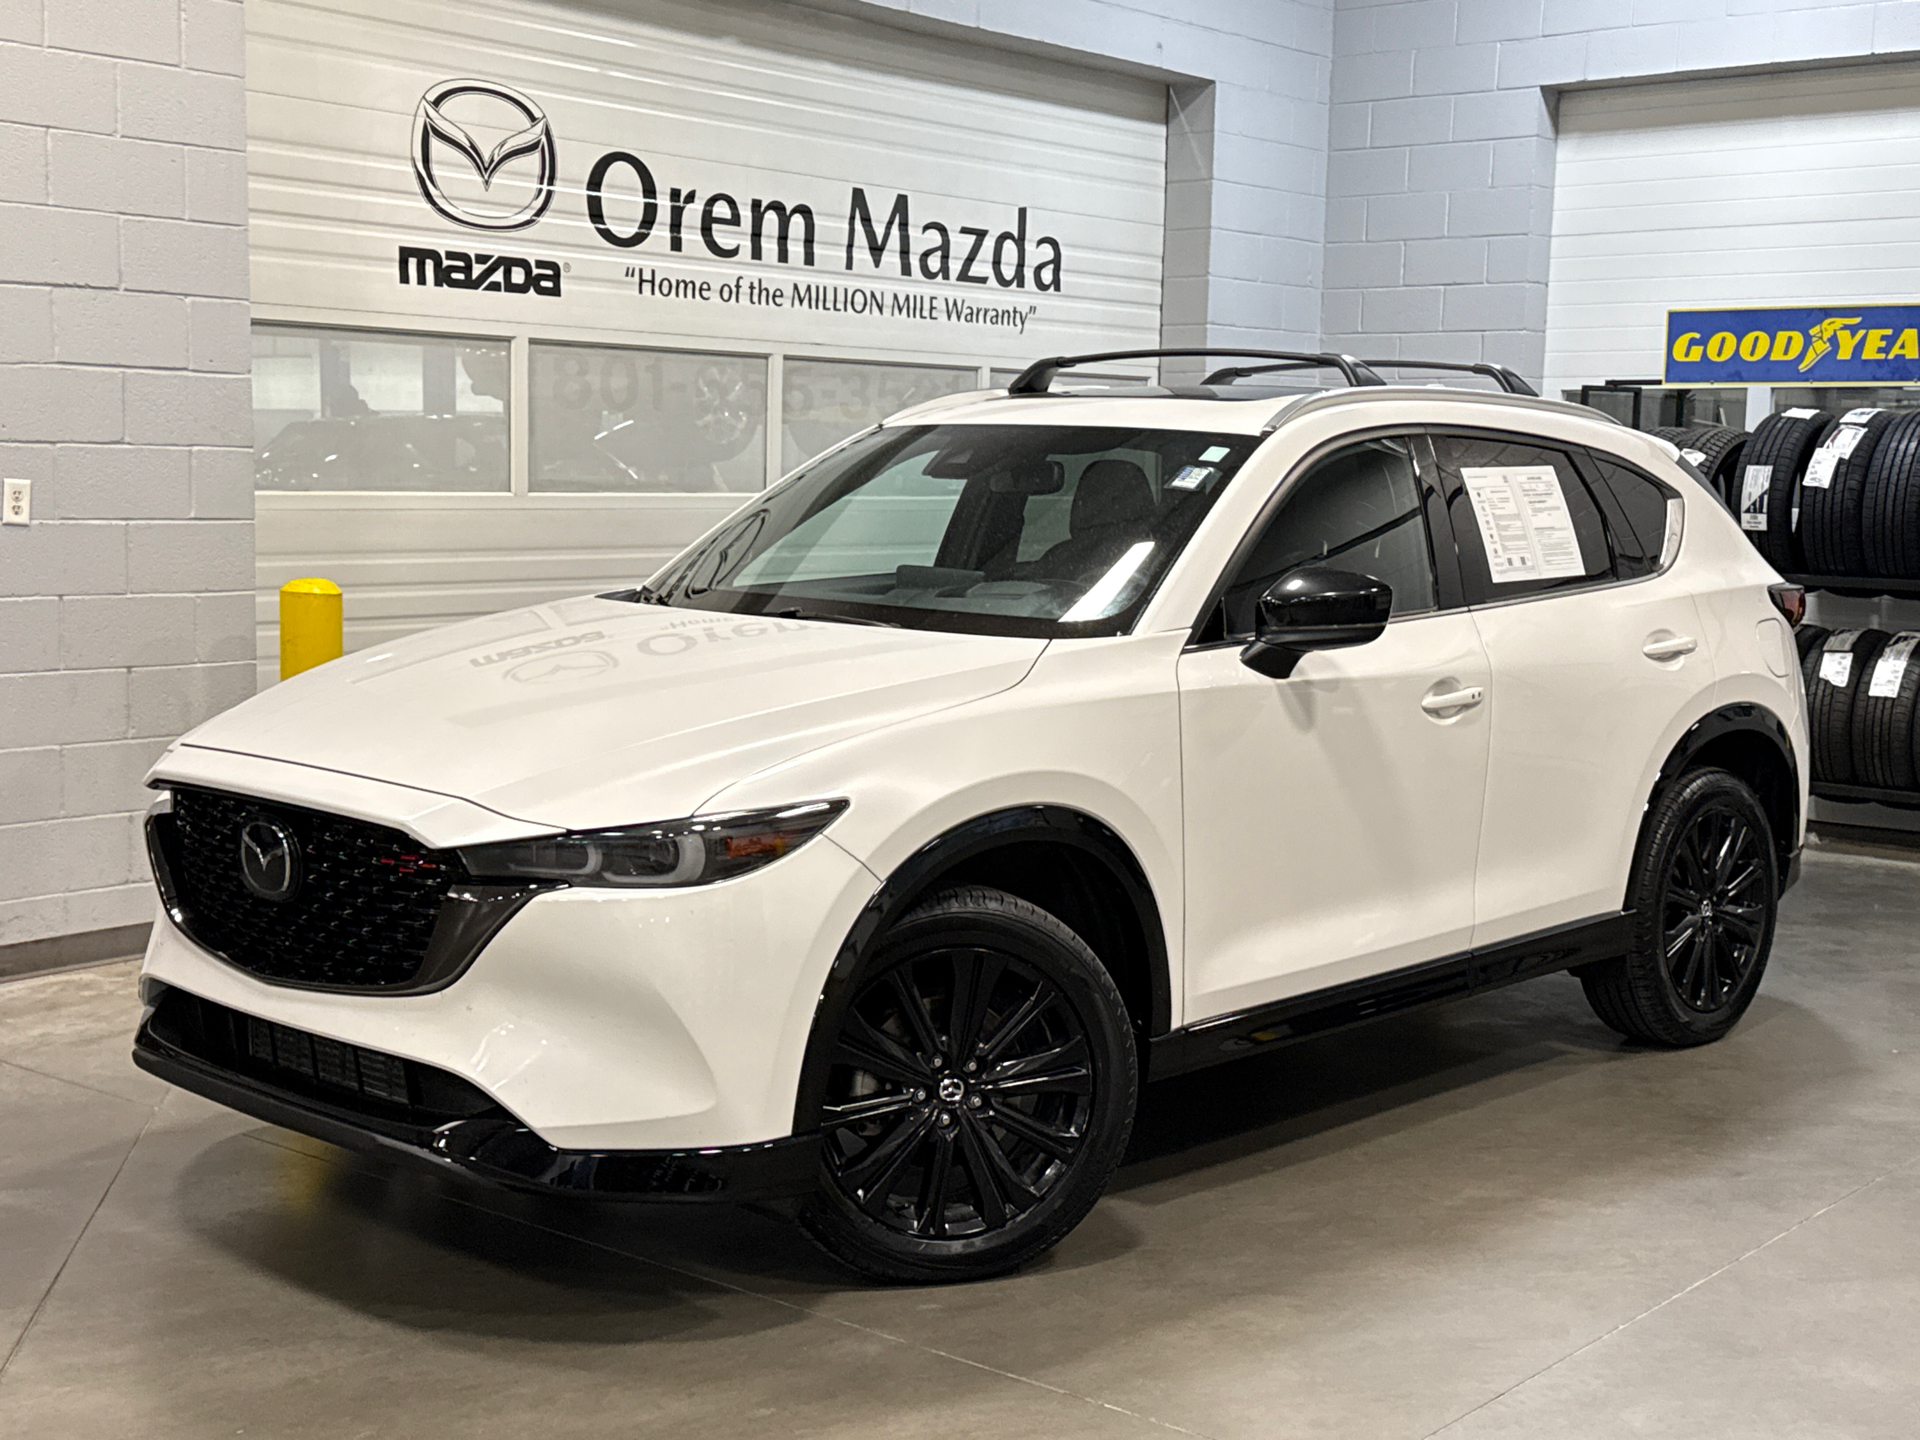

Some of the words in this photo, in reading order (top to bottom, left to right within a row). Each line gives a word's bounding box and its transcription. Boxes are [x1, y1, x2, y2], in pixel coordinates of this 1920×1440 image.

[585, 150, 816, 268] Orem
[845, 186, 1062, 293] Mazda
[398, 245, 562, 298] mazda
[624, 266, 711, 301] “Home
[719, 275, 744, 304] of
[748, 278, 784, 308] the
[790, 282, 885, 316] MILLION
[890, 292, 939, 321] MILE
[944, 297, 1037, 335] Warranty”
[1672, 327, 1920, 362] GOODYEA
